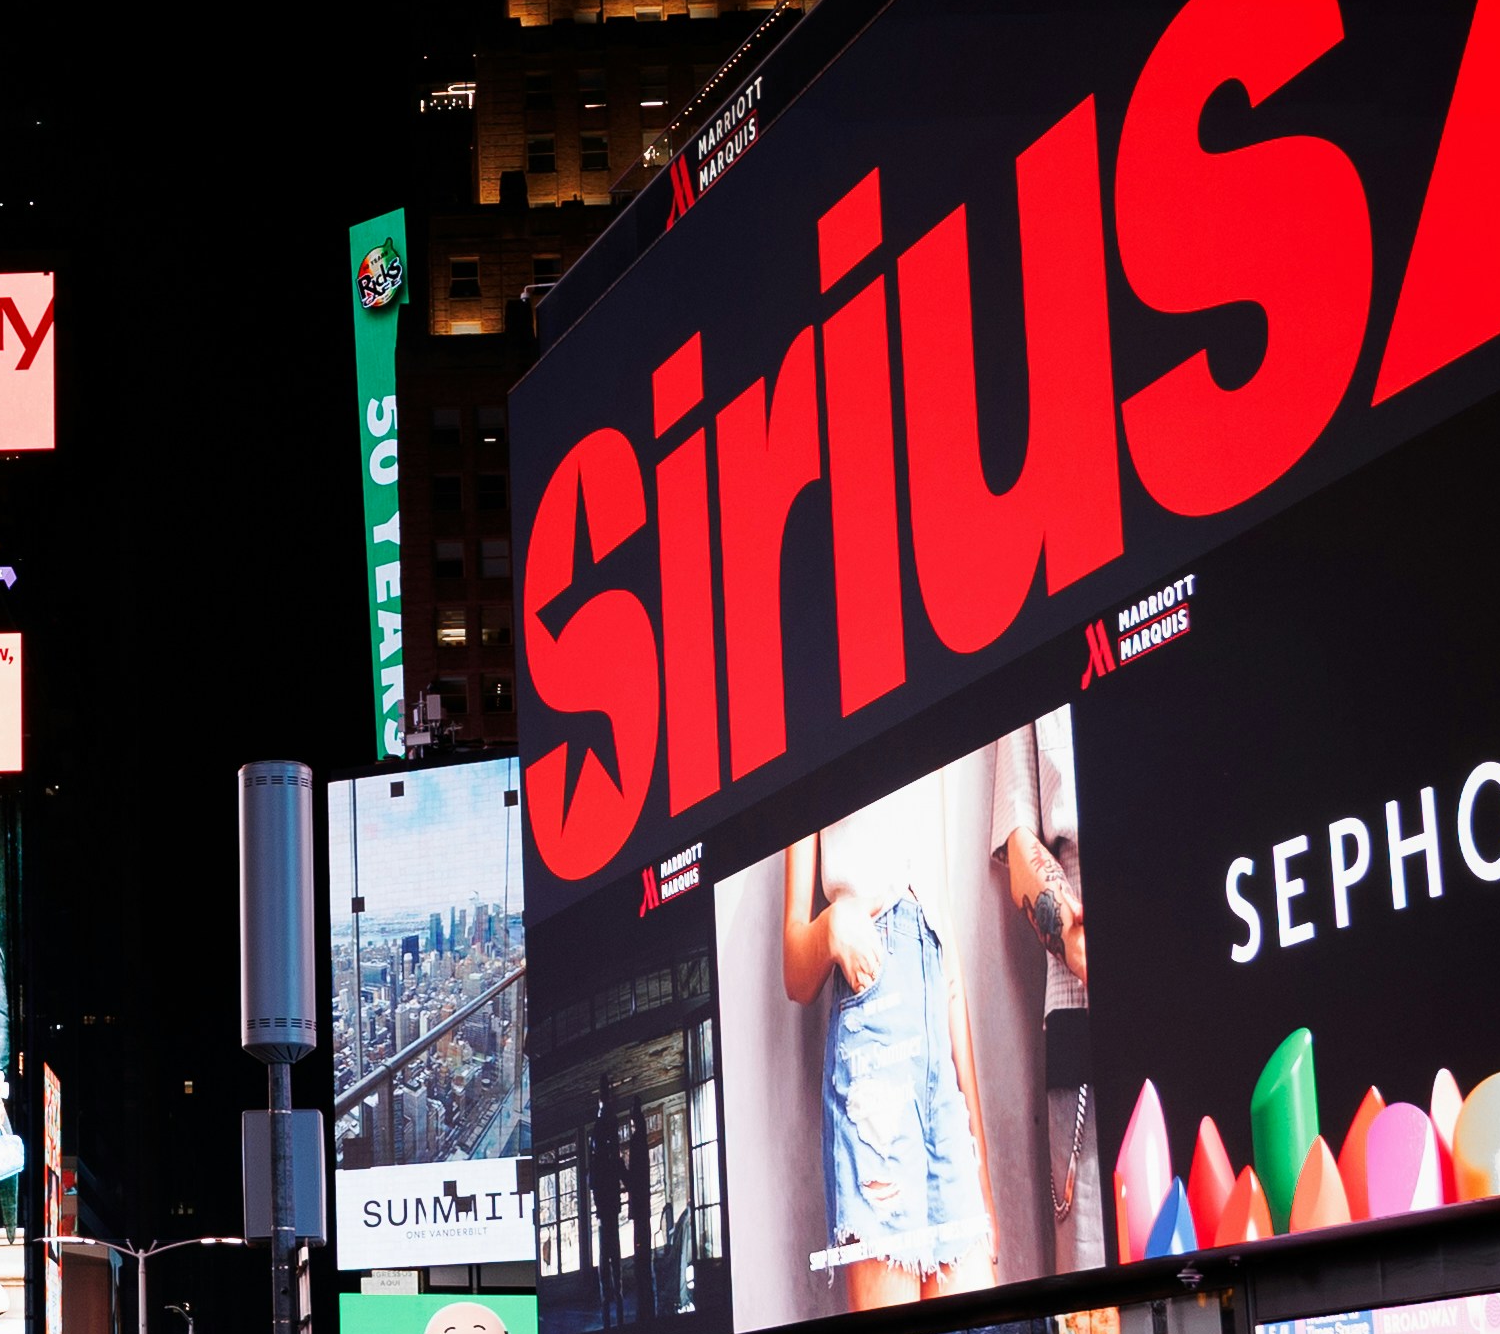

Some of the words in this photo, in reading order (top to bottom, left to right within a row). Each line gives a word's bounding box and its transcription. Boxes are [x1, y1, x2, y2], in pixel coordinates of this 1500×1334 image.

[698, 76, 763, 160] MARRIOTT
[700, 118, 756, 191] MARQUIS
[366, 395, 399, 486] 50
[1118, 574, 1195, 632] MARRIOTT
[1120, 609, 1188, 660] MARQUIS
[660, 842, 703, 878] MARRIOTT
[661, 867, 699, 899] MARQUIS
[406, 1231, 425, 1239] ONE
[430, 1227, 488, 1237] VANDERBILT
[1383, 1310, 1458, 1333] BROADWAY
